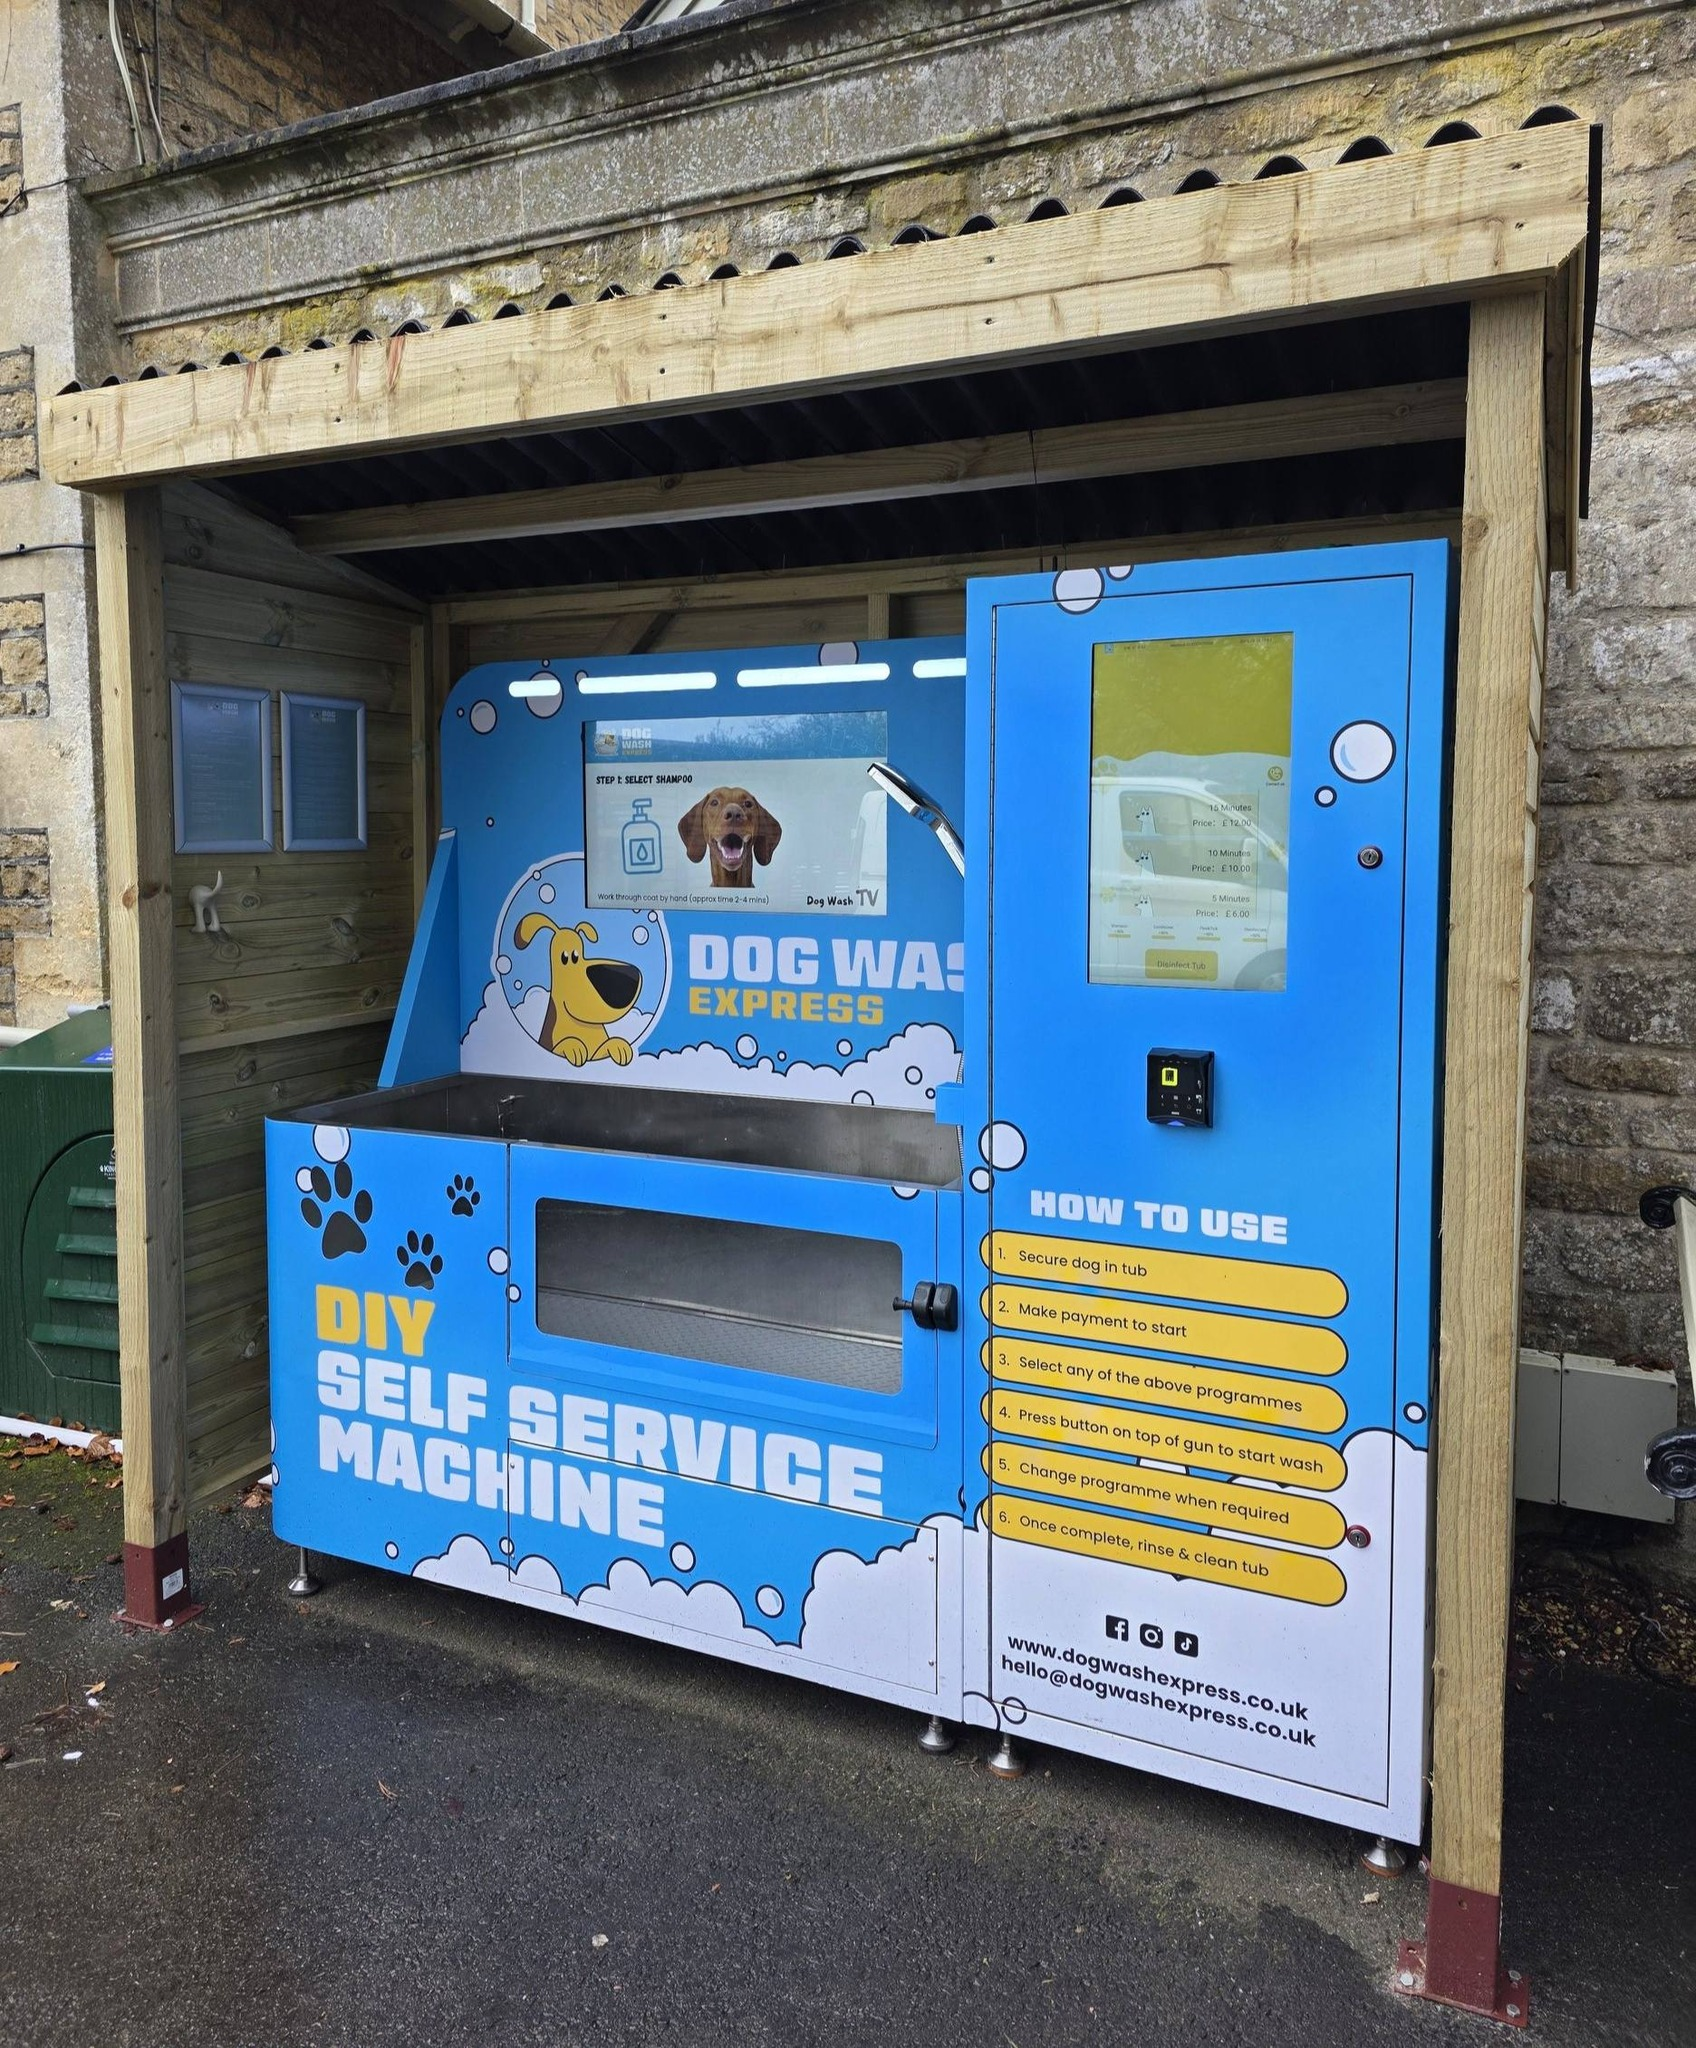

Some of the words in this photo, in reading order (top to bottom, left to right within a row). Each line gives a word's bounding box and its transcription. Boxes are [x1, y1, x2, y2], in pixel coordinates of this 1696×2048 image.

[622, 728, 652, 739] DOG
[622, 740, 652, 749] WASH
[596, 776, 615, 784] STEP
[625, 775, 653, 784] SELECT
[656, 774, 693, 784] SHAMPOO
[1221, 804, 1252, 812] Minutes
[1191, 864, 1215, 873] Price:
[1208, 849, 1218, 857] 10
[1220, 849, 1251, 857] Minutes
[598, 893, 614, 901] Work
[616, 893, 641, 903] through
[643, 894, 658, 902] coat
[660, 894, 668, 904] by
[670, 895, 688, 903] hand
[689, 893, 716, 905] (approx
[717, 896, 734, 904] time
[749, 895, 769, 905] mins)
[806, 895, 825, 908] Dog
[827, 895, 853, 906] Wash
[855, 887, 879, 907] TV
[1195, 909, 1219, 918] Price:
[1219, 894, 1250, 903] Minutes
[689, 934, 819, 985] DOG
[1157, 959, 1190, 970] Disinfect
[1193, 961, 1207, 970] Tub
[689, 986, 884, 1025] EXPRESS
[1030, 1189, 1124, 1226] HOW
[1133, 1200, 1189, 1233] TO
[1200, 1208, 1288, 1245] USE
[998, 1247, 1006, 1260] 1.
[1019, 1250, 1068, 1267] Secure
[1072, 1257, 1101, 1275] dog
[1104, 1259, 1118, 1273] in
[1122, 1263, 1148, 1277] tub
[315, 1284, 435, 1357] DIY
[998, 1300, 1009, 1313] 2.
[1019, 1302, 1057, 1319] Make
[1061, 1309, 1129, 1329] payment
[1132, 1318, 1147, 1331] to
[1151, 1321, 1187, 1338] start
[998, 1353, 1010, 1366] 3.
[1019, 1356, 1063, 1374] Select
[1066, 1365, 1094, 1381] any
[1097, 1368, 1113, 1381] of
[1116, 1371, 1140, 1385] the
[1144, 1376, 1192, 1394] above
[1196, 1385, 1303, 1413] programmes
[317, 1350, 488, 1434] SELF
[508, 1385, 883, 1518] SERVICE
[998, 1406, 1011, 1419] 4.
[1019, 1409, 1056, 1426] Press
[1060, 1415, 1109, 1435] button
[1112, 1426, 1131, 1439] on
[1135, 1428, 1160, 1447] top
[1164, 1434, 1180, 1447] of
[1183, 1438, 1214, 1454] gun
[1218, 1443, 1234, 1457] to
[1238, 1448, 1275, 1465] start
[1279, 1455, 1324, 1473] wash
[319, 1414, 665, 1548] MACHINE
[998, 1458, 1010, 1471] 5.
[1019, 1462, 1077, 1485] Change
[1080, 1474, 1172, 1501] programme
[1175, 1493, 1218, 1510] when
[1221, 1502, 1290, 1525] required
[999, 1510, 1011, 1524] 6.
[1019, 1515, 1057, 1533] Once
[1060, 1526, 1134, 1551] complete,
[1138, 1540, 1175, 1557] rinse
[1178, 1547, 1190, 1561] &
[1194, 1551, 1238, 1571] clean
[1242, 1560, 1270, 1577] tub
[1007, 1635, 1310, 1721] www.dogwashexpress.co.uk
[1001, 1654, 1318, 1748] hello@dogwashexpress.co.uk
